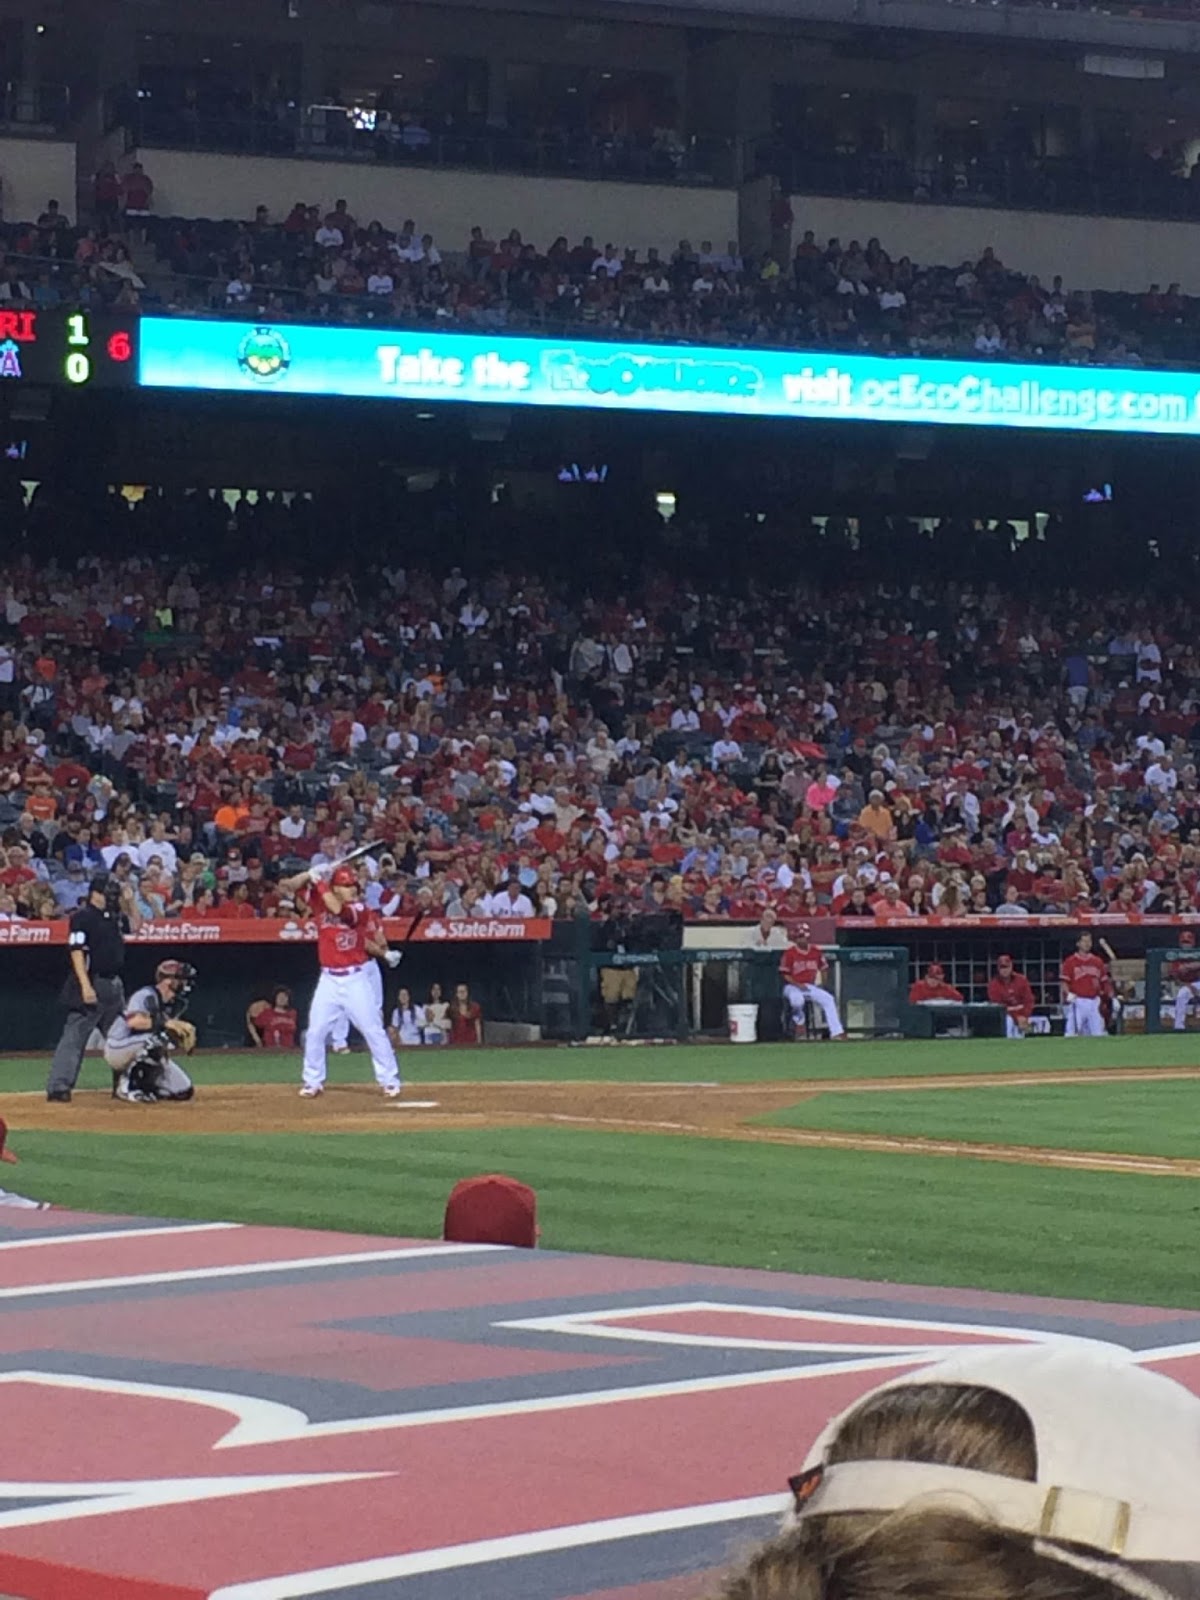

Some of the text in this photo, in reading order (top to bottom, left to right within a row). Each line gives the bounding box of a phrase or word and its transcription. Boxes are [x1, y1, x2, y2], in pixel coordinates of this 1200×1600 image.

[68, 315, 89, 345] 1
[108, 332, 131, 362] 6
[67, 353, 89, 383] 0
[377, 345, 465, 388] Take
[472, 352, 531, 391] the
